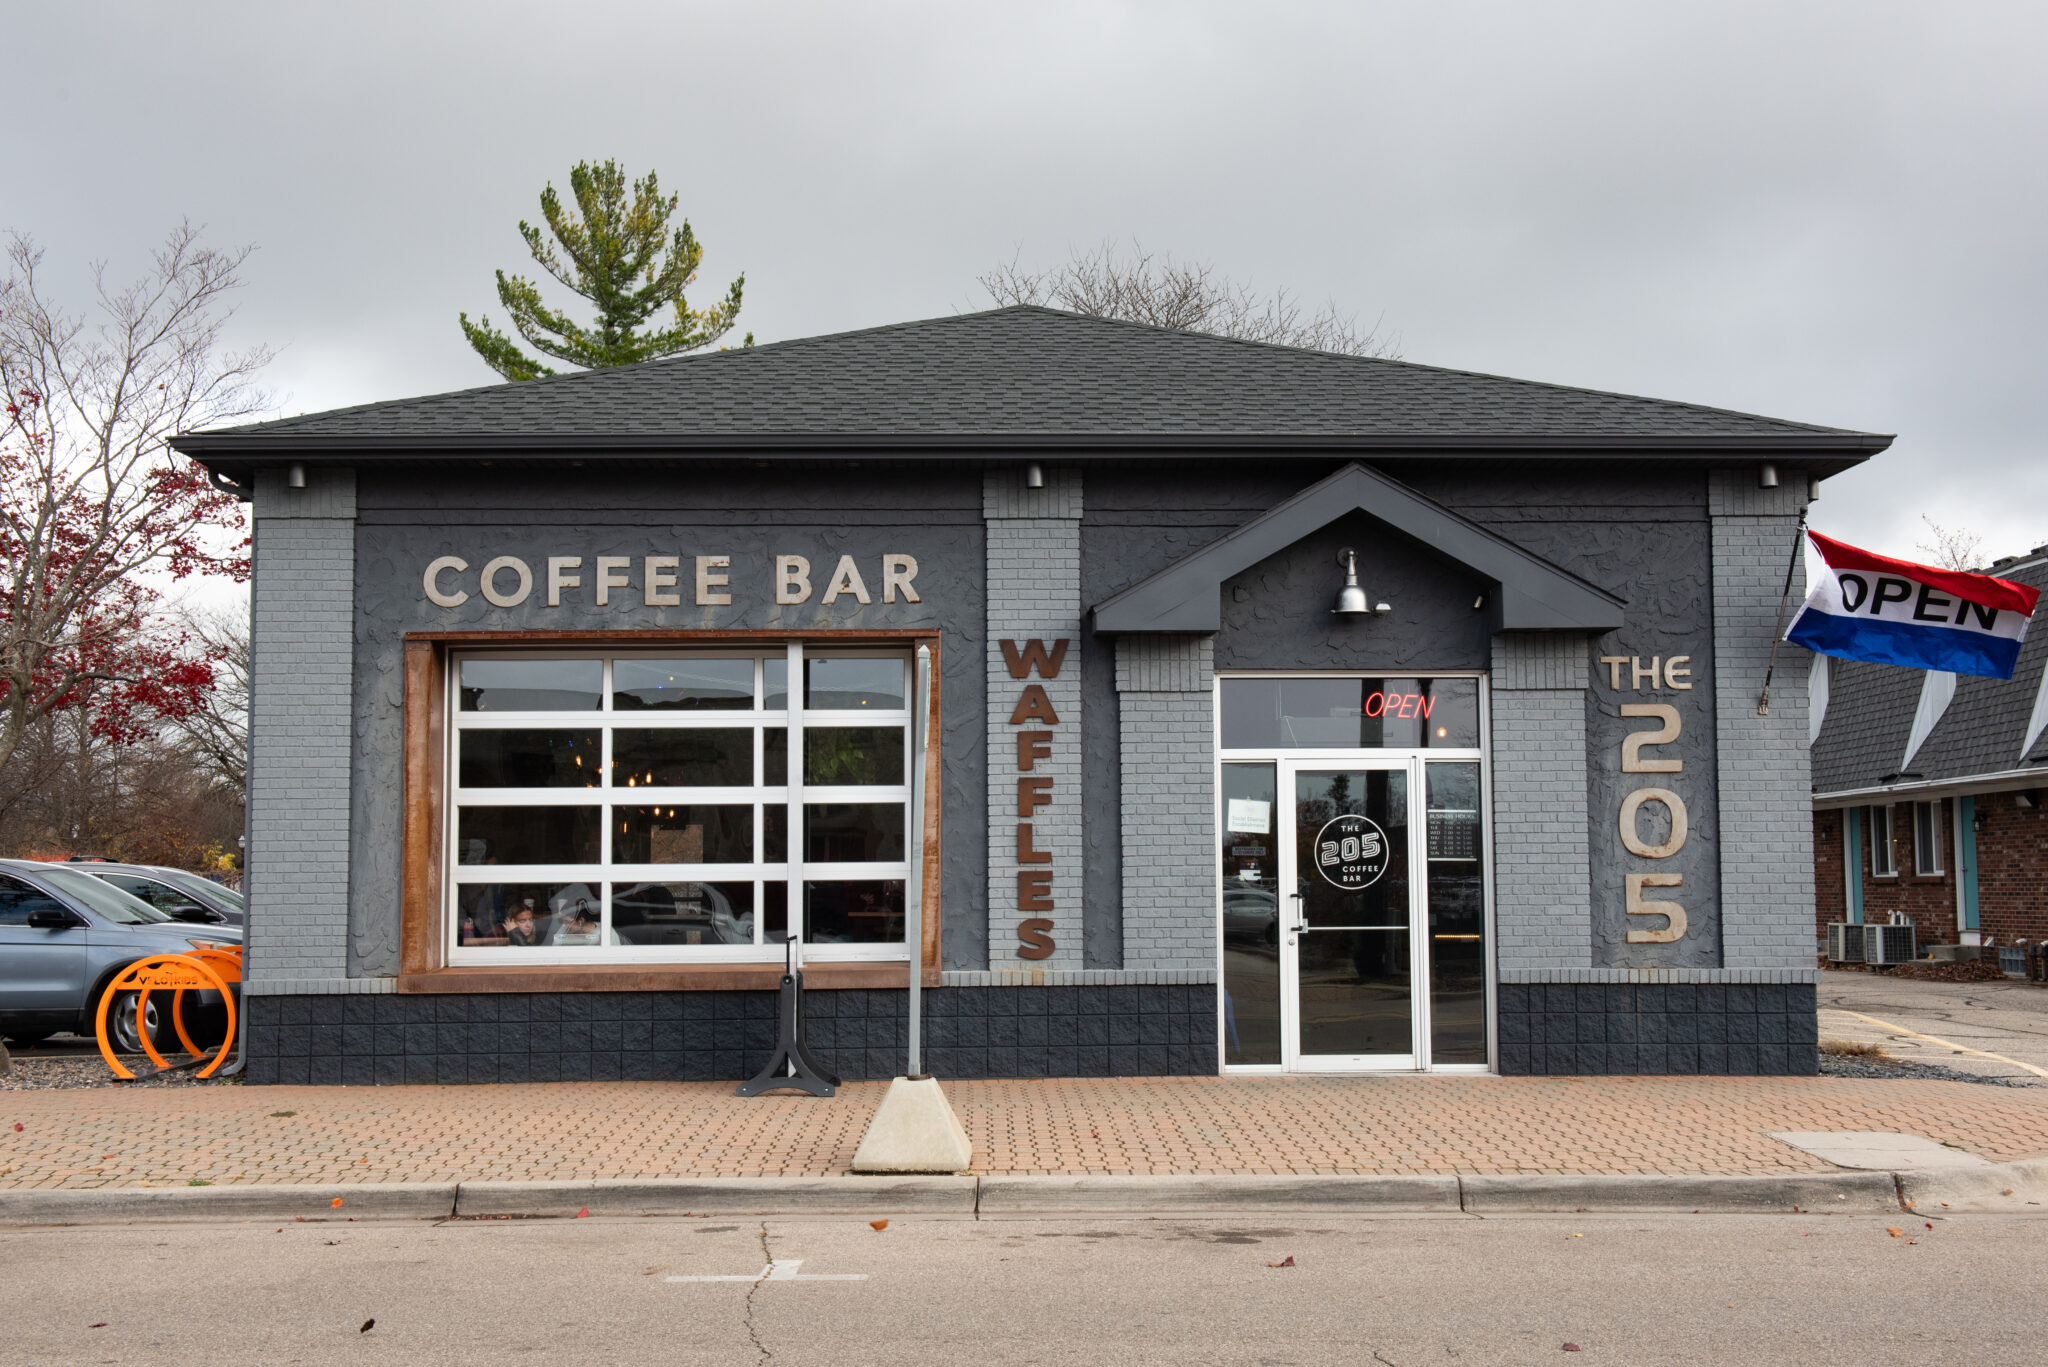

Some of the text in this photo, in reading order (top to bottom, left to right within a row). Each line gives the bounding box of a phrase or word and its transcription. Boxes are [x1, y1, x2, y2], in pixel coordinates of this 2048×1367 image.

[423, 553, 922, 608] COFFEE BAR
[1839, 573, 1998, 631] OPEN
[1600, 655, 1693, 690] THE
[1365, 692, 1436, 719] OPEN
[998, 638, 1070, 960] WAFFLES
[1619, 703, 1688, 944] 205
[1321, 832, 1381, 867] 205
[1342, 865, 1379, 873] COFFEE
